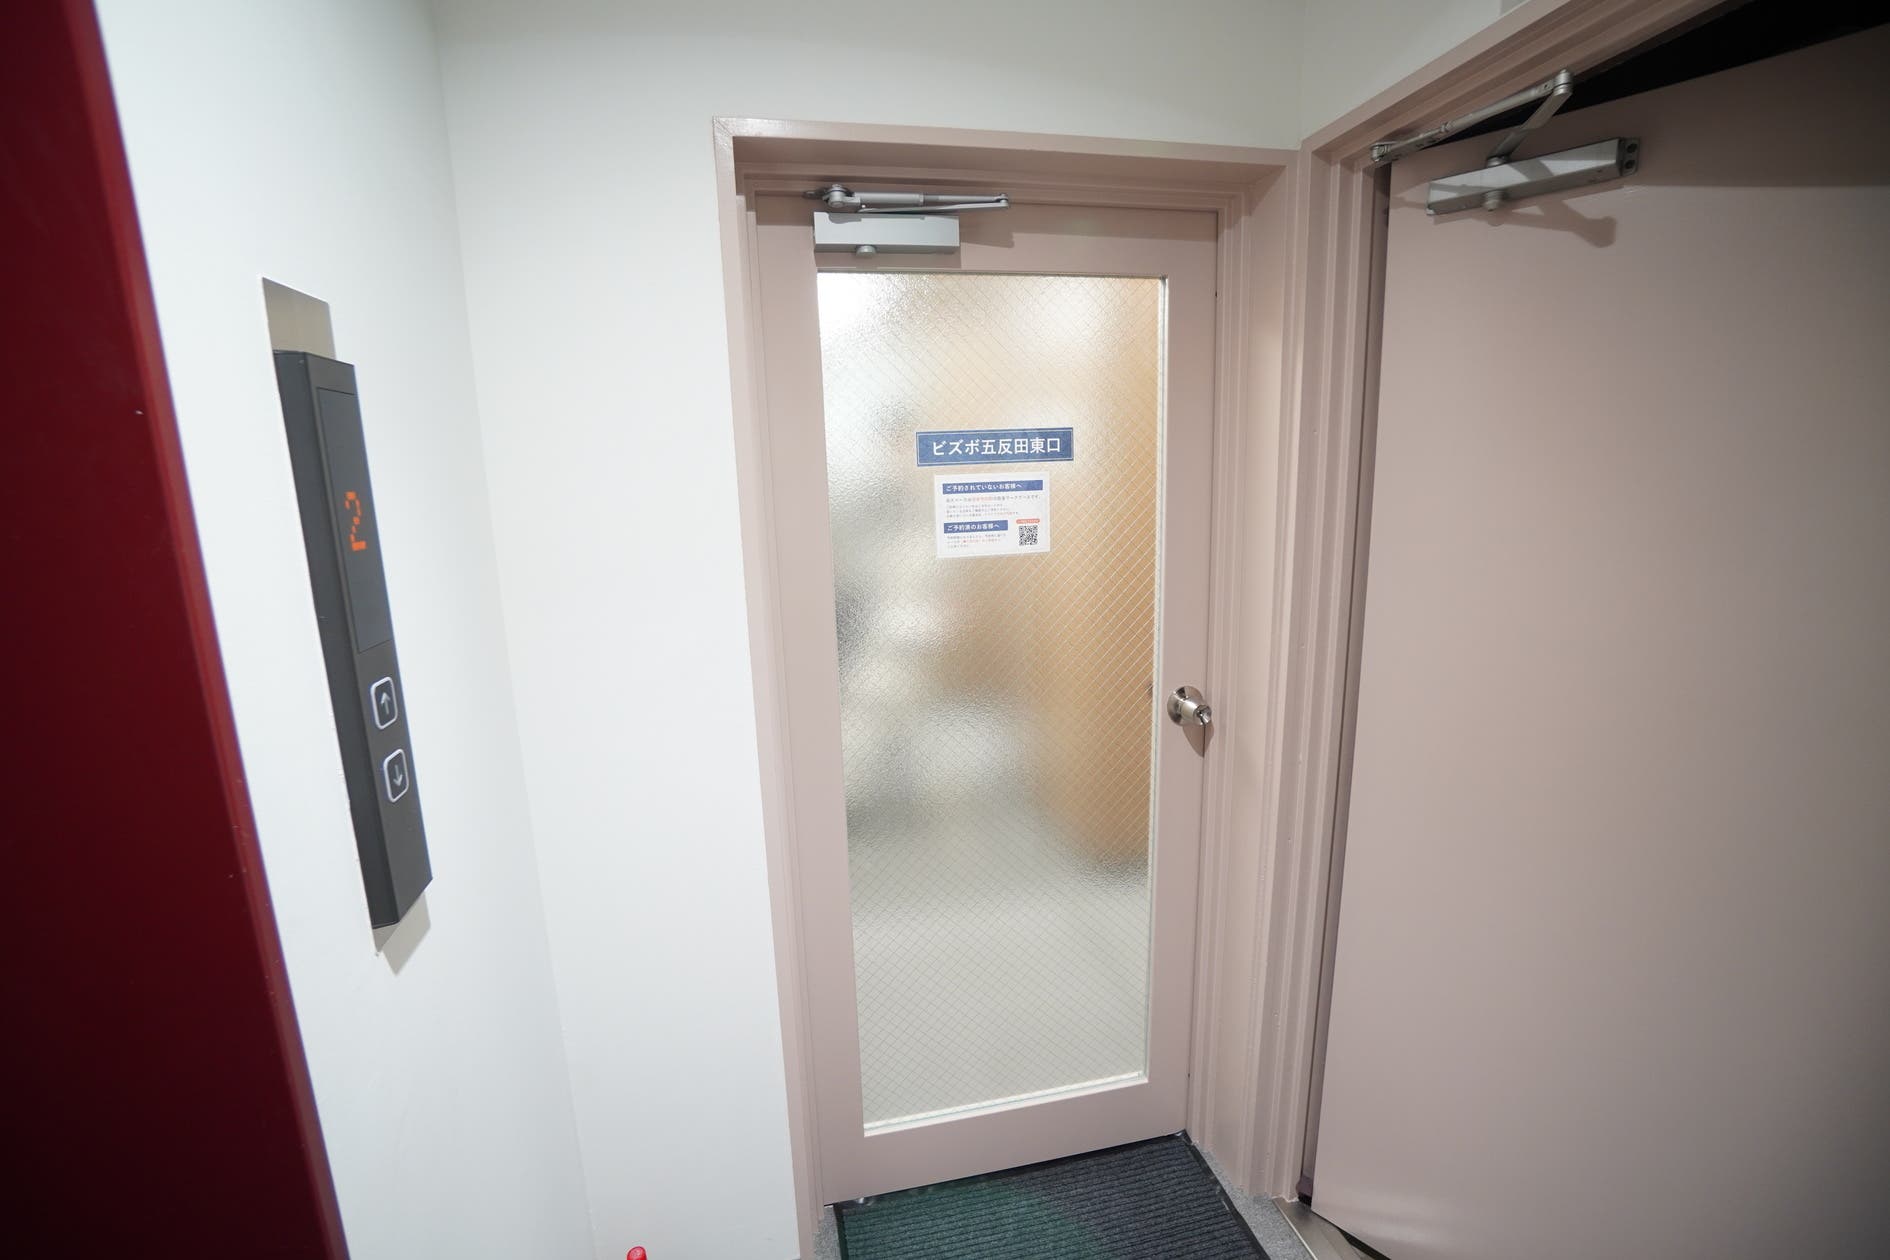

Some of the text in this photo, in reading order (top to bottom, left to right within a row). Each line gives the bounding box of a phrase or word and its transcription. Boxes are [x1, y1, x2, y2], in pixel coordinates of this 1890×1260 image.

[946, 483, 1023, 492] ご予約されていないお客様へ
[345, 490, 368, 551] 2
